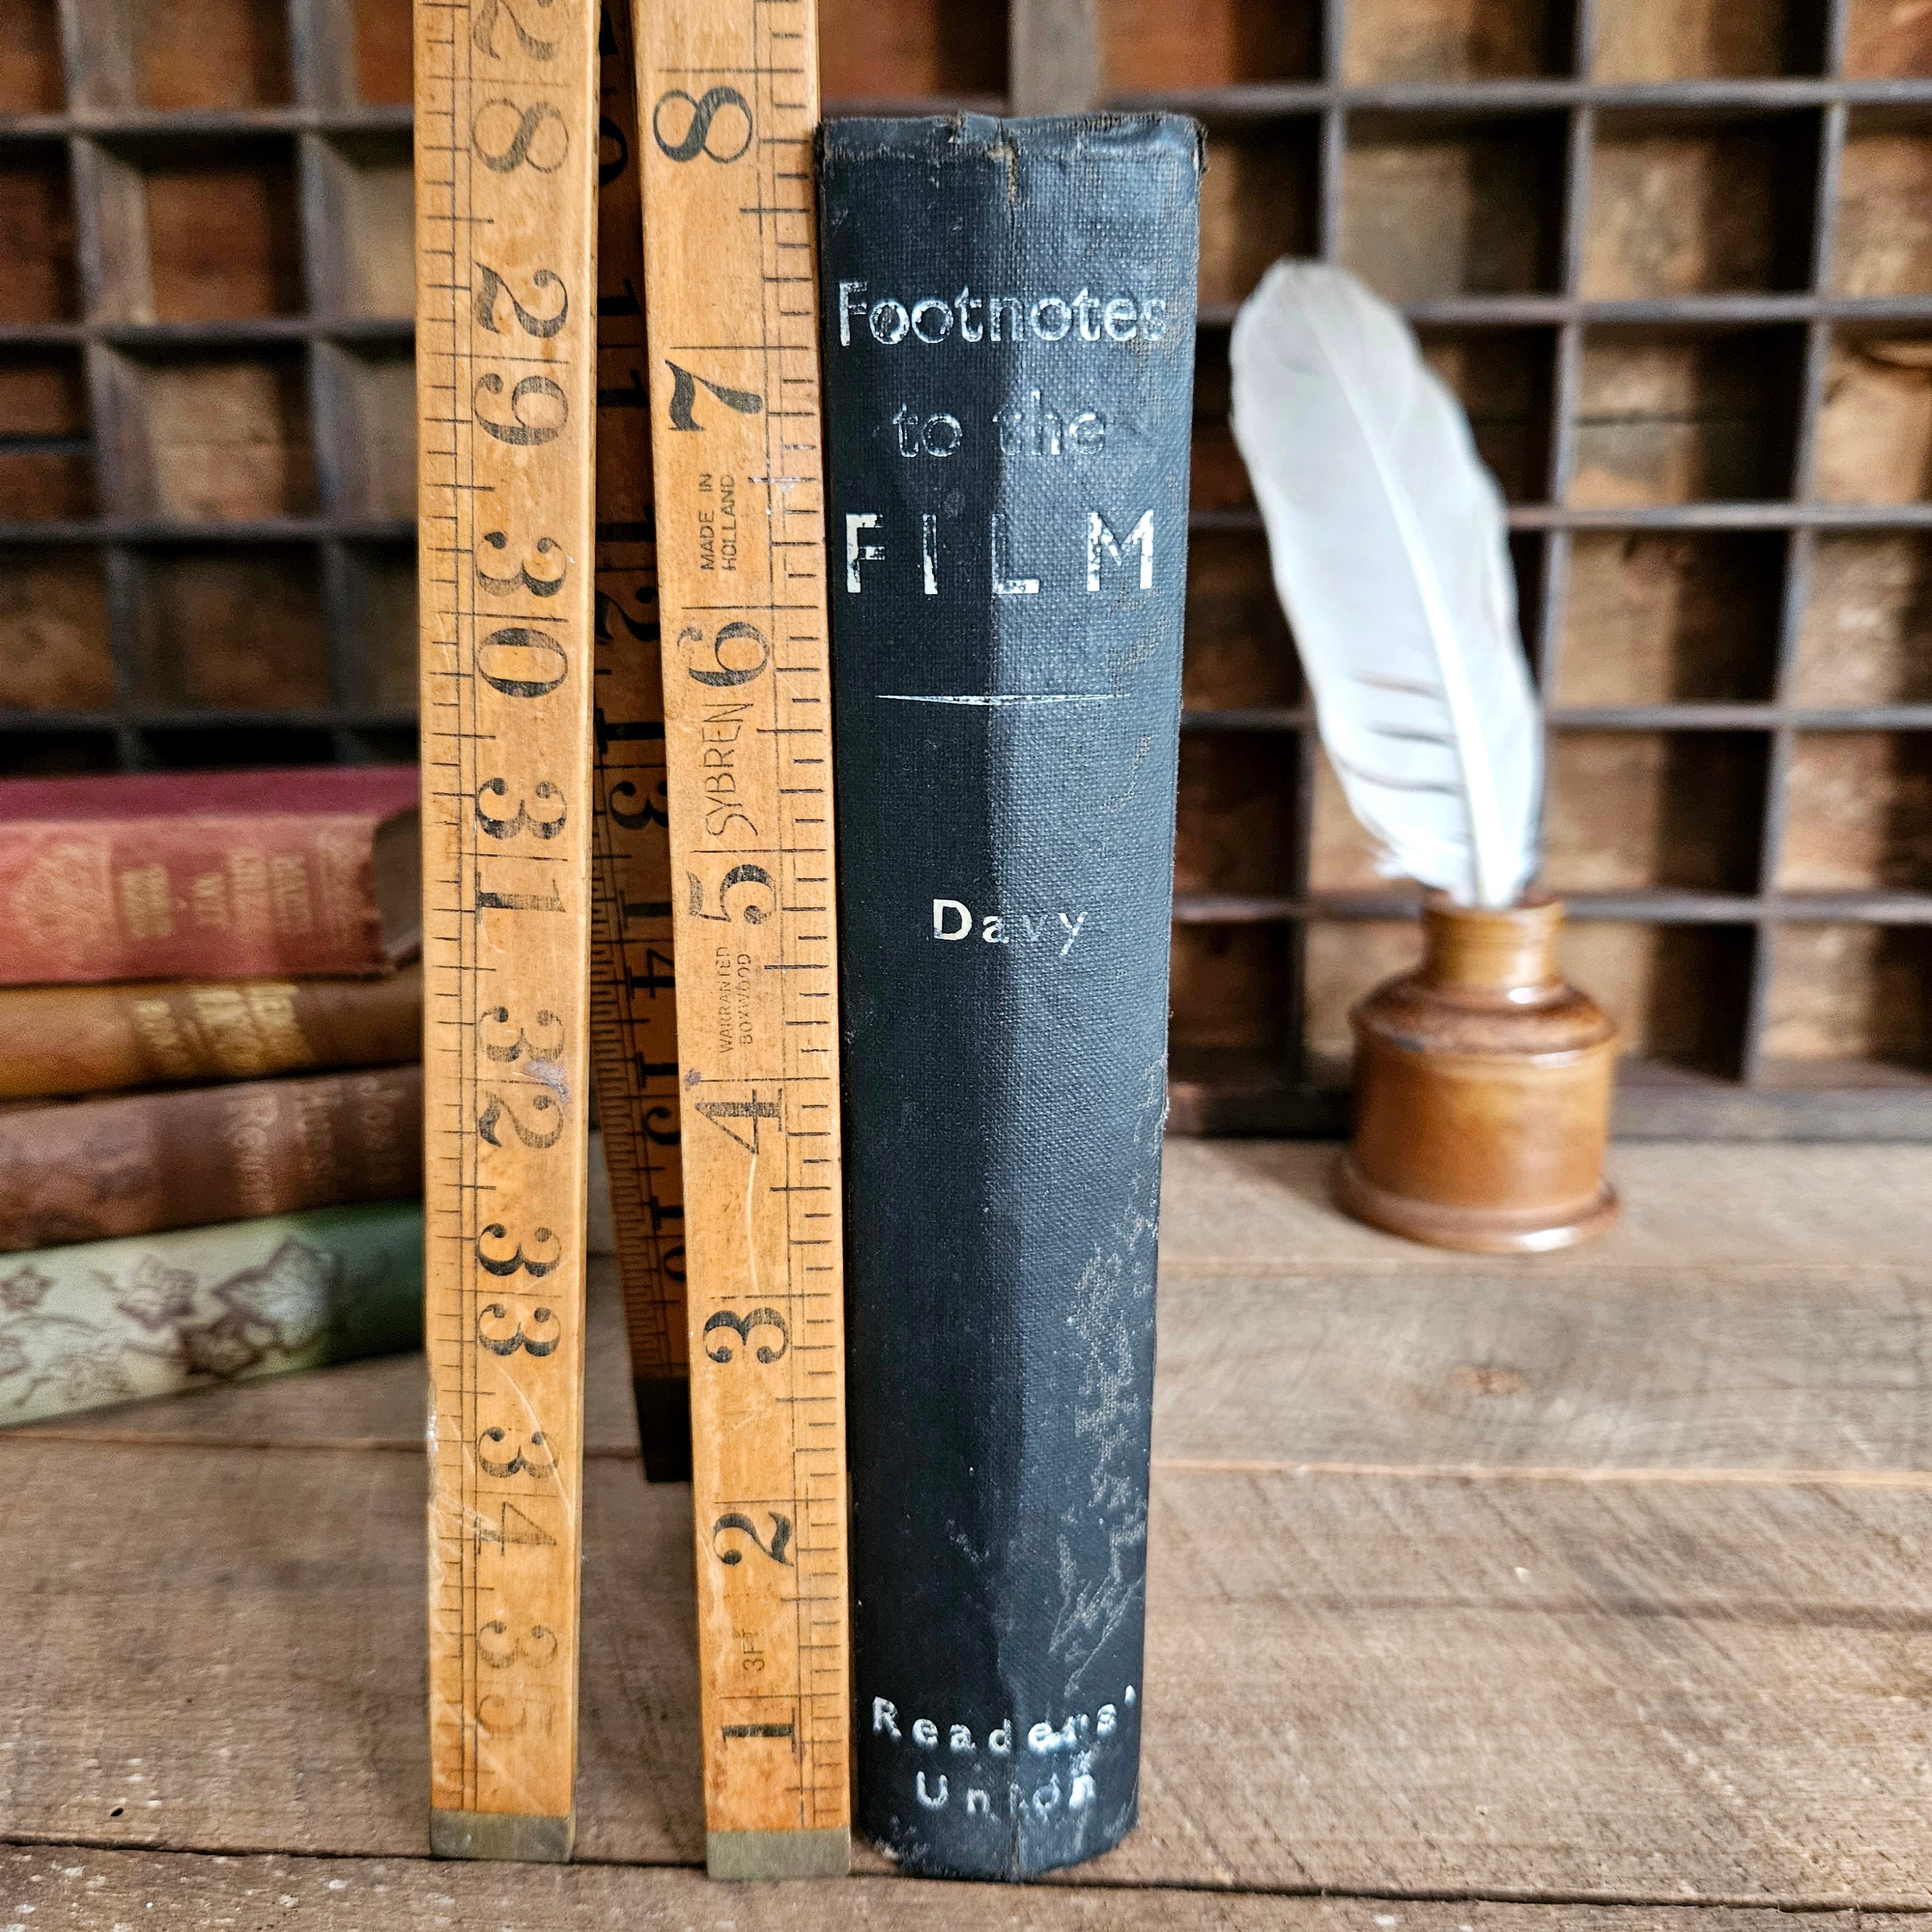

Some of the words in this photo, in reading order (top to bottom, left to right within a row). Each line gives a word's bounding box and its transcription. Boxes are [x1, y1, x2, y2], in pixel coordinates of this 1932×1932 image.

[653, 87, 753, 163] 8
[839, 280, 1166, 347] Footnotes
[664, 358, 763, 432] 7
[892, 403, 963, 457] to
[992, 387, 1105, 456] the
[699, 473, 713, 493] IN
[699, 510, 715, 571] MADE
[719, 474, 737, 571] HOLLAND
[845, 509, 1155, 595] FILM
[677, 621, 770, 687] 6
[702, 703, 759, 837] SYBREN
[686, 863, 777, 925] 5
[933, 898, 1088, 956] Davy
[715, 946, 734, 1053] WARRANTED
[737, 953, 754, 1045] BOXWOOD
[694, 1089, 783, 1155] 4
[703, 1307, 789, 1364] 3
[713, 1511, 795, 1567] 2
[719, 1707, 797, 1754] 1
